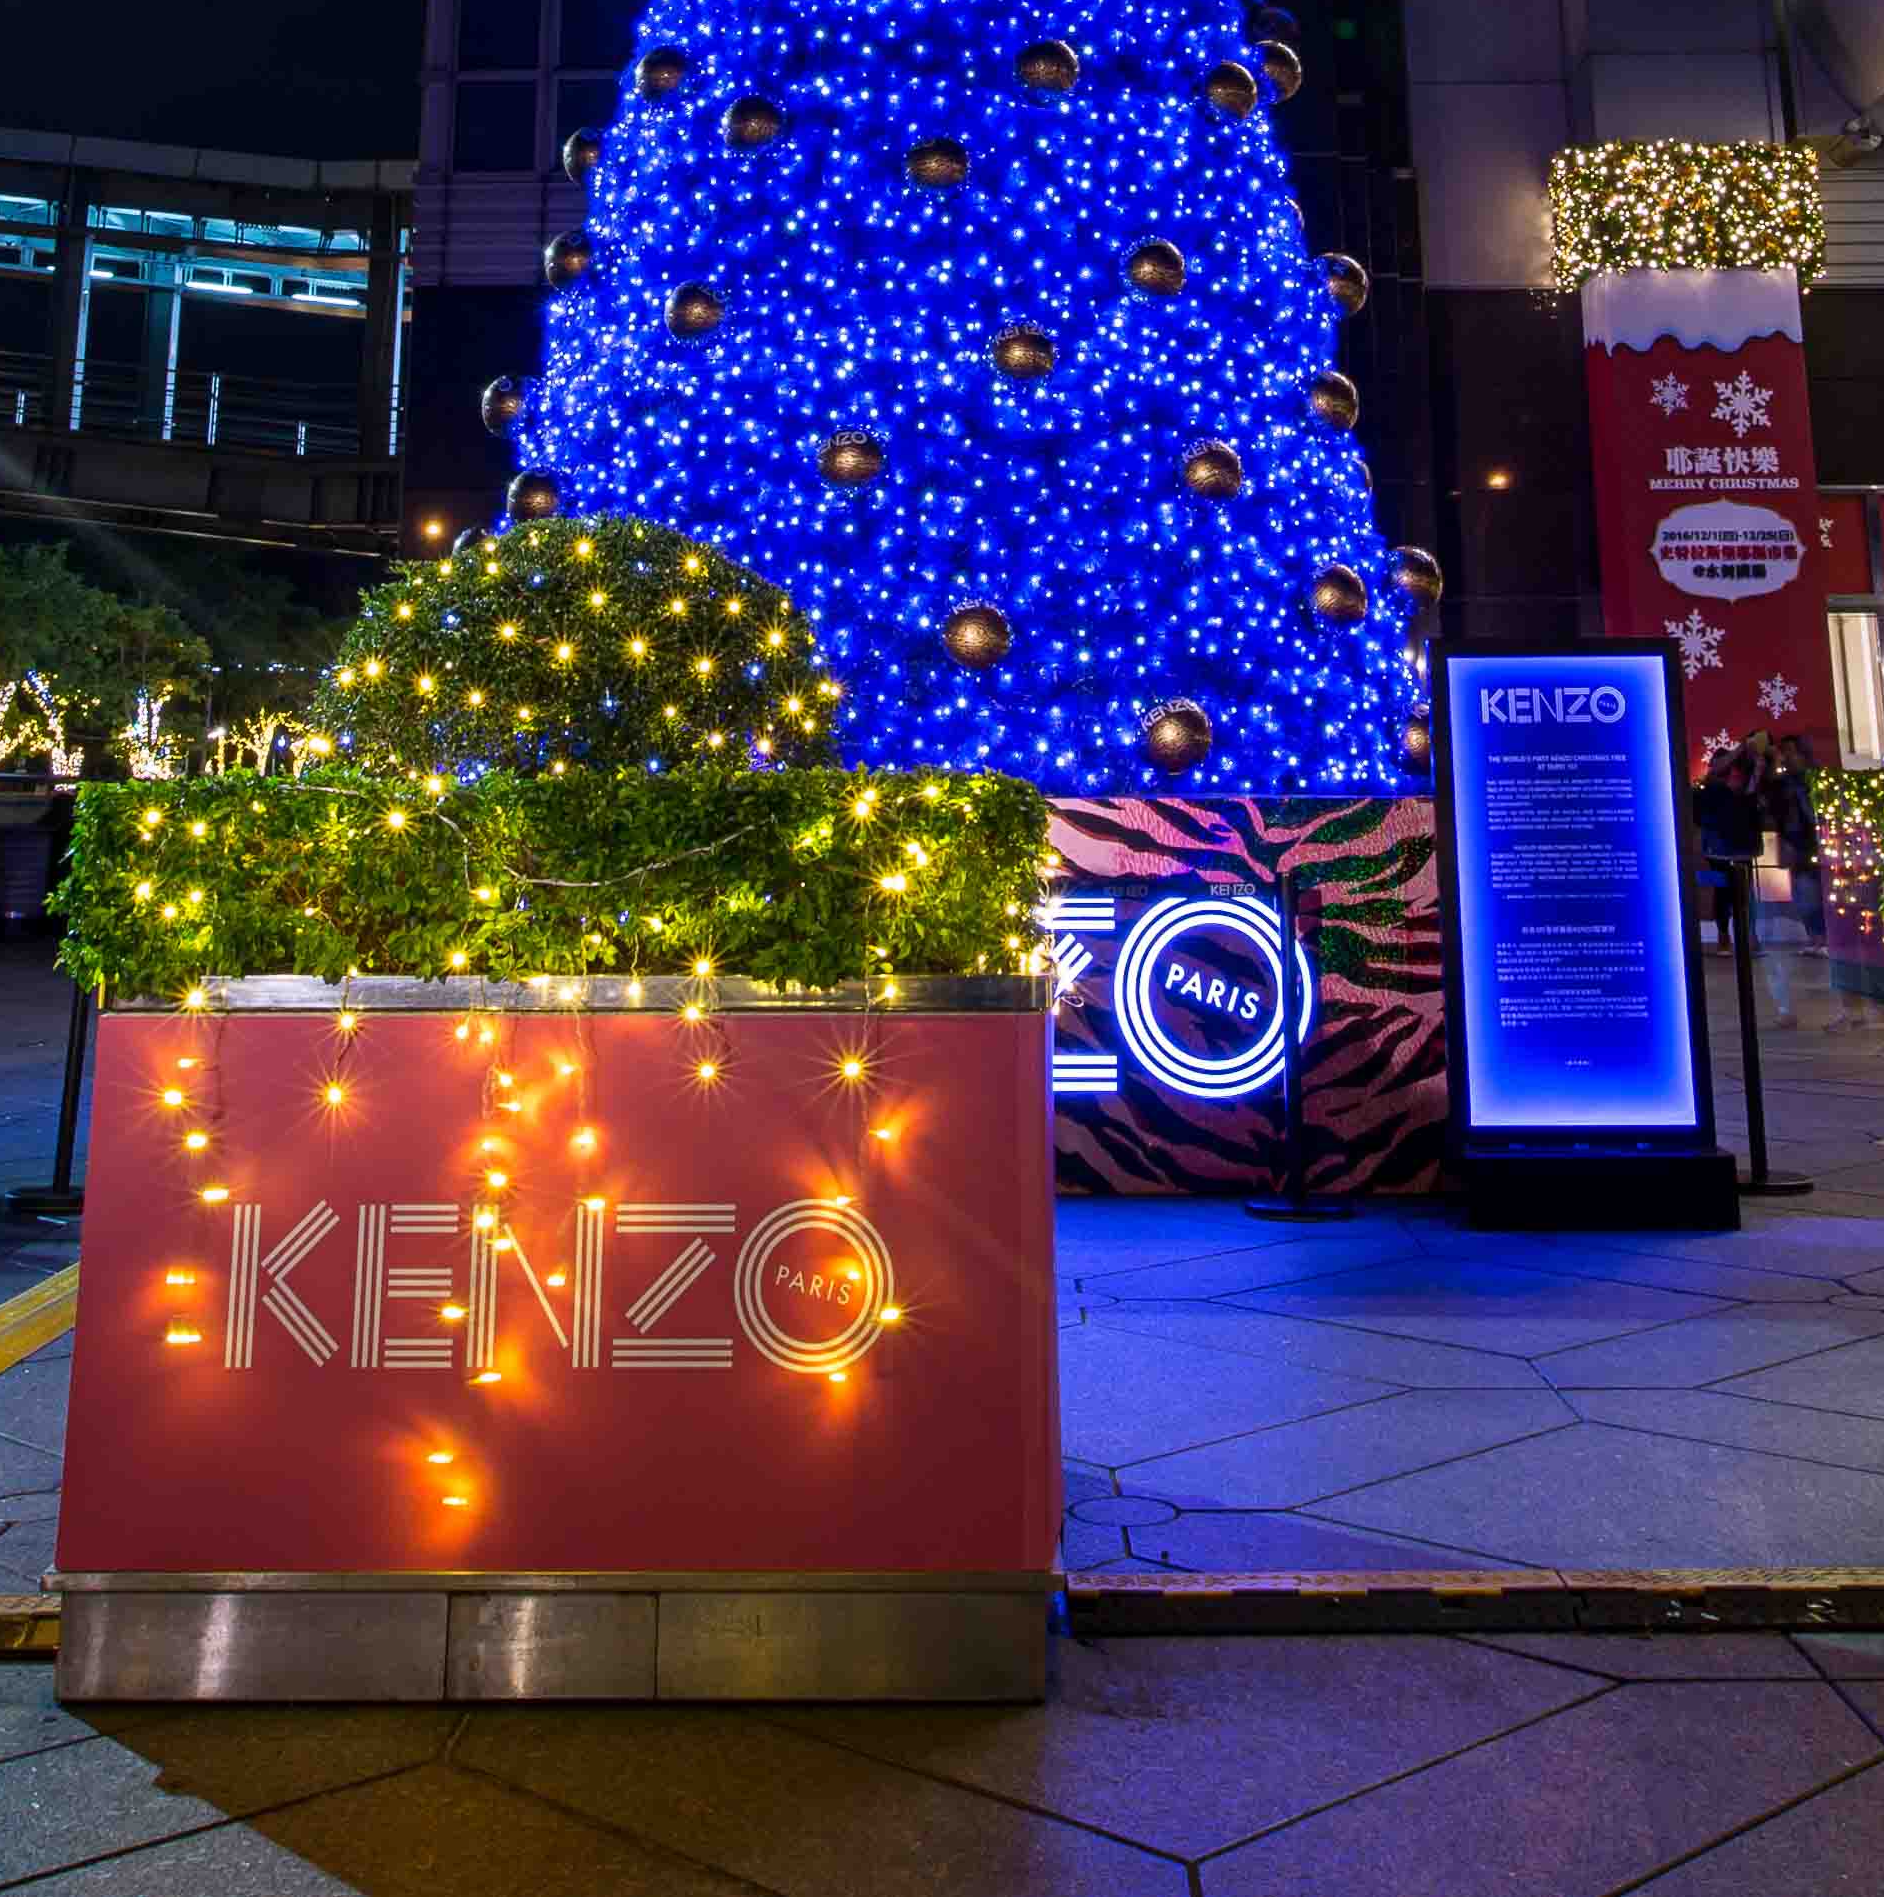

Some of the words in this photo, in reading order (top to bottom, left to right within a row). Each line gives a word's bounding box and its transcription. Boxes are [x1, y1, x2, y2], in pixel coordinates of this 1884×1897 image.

[1665, 445, 1780, 475] 耶誕快樂
[1649, 478, 1705, 490] MERRY
[1709, 477, 1800, 490] CHRISTMAS
[1480, 686, 1626, 724] KENZO
[1165, 962, 1261, 1020] PARIS
[225, 1199, 895, 1374] KENZO
[775, 1265, 852, 1305] PARIS
